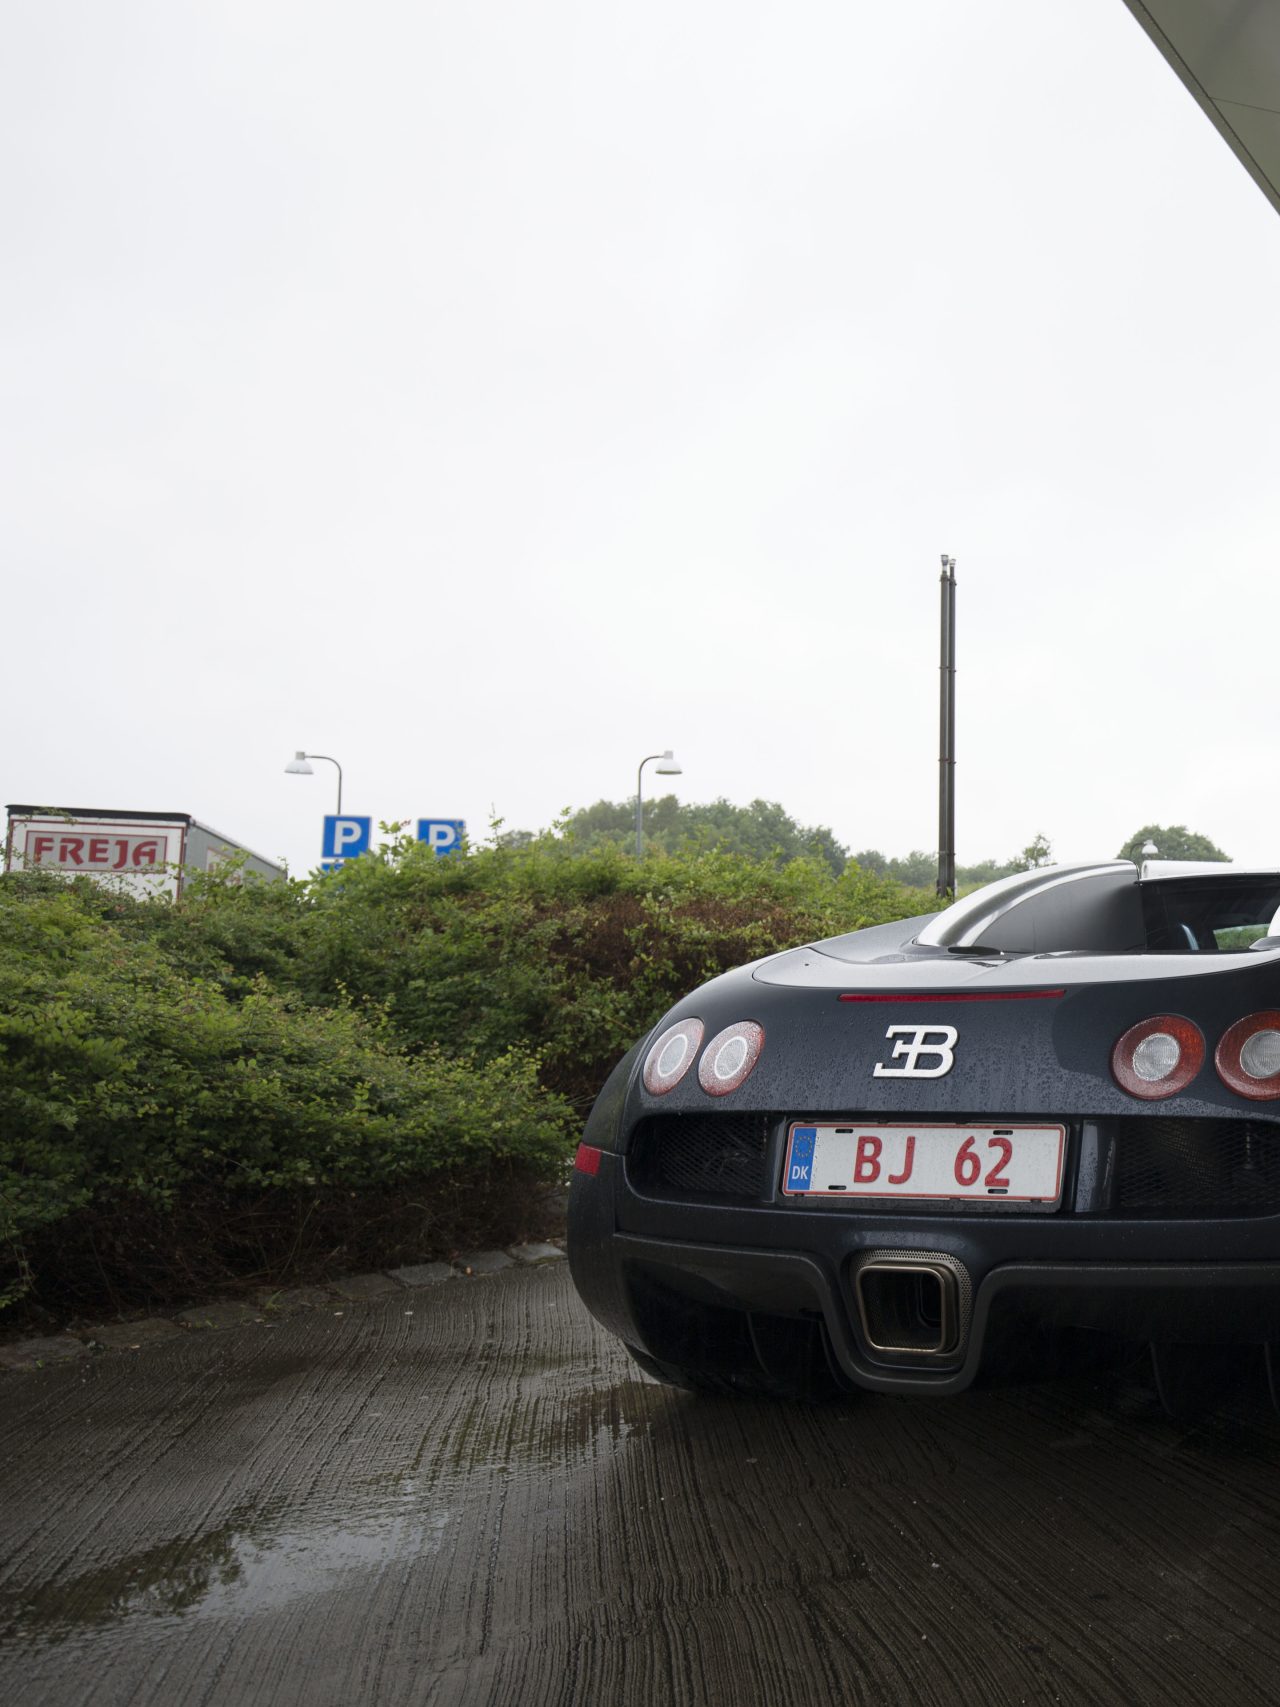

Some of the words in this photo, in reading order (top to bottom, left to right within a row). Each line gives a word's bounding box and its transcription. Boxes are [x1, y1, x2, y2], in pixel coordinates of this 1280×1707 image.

[34, 836, 159, 869] FREJA
[333, 820, 362, 855] P
[428, 824, 456, 850] P
[792, 1165, 809, 1180] DK
[853, 1135, 916, 1184] BJ
[954, 1135, 1013, 1187] 62
